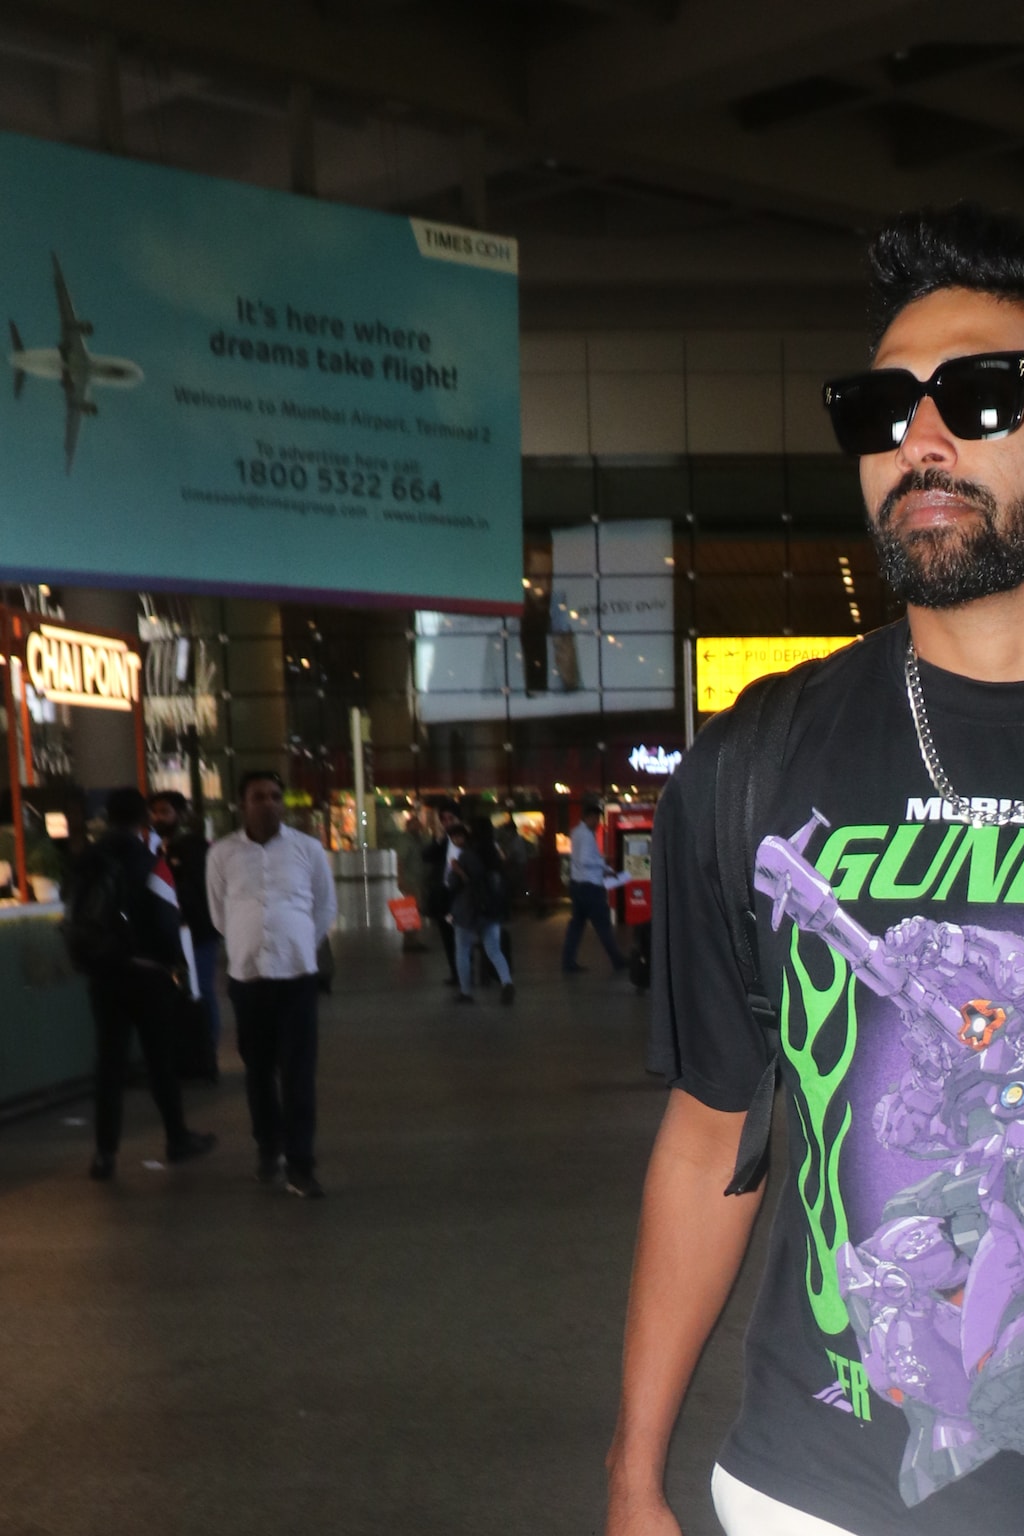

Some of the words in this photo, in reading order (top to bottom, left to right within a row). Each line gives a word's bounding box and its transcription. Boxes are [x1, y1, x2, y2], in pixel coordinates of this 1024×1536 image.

[424, 229, 474, 254] TIMES
[475, 240, 511, 261] OOH
[237, 295, 278, 330] It's
[286, 302, 346, 340] here
[352, 319, 432, 354] where
[209, 326, 310, 370] dreams
[316, 346, 375, 380] take
[381, 353, 459, 393] flight!
[173, 384, 253, 413] Welcome
[258, 399, 277, 416] to
[281, 400, 347, 424] Mumbai
[415, 415, 479, 441] Terminal
[255, 438, 274, 458] To
[234, 457, 307, 492] 1800
[317, 467, 382, 500] 5322
[391, 474, 443, 504] 664
[26, 631, 85, 696] CHAI
[81, 643, 142, 703] POINT
